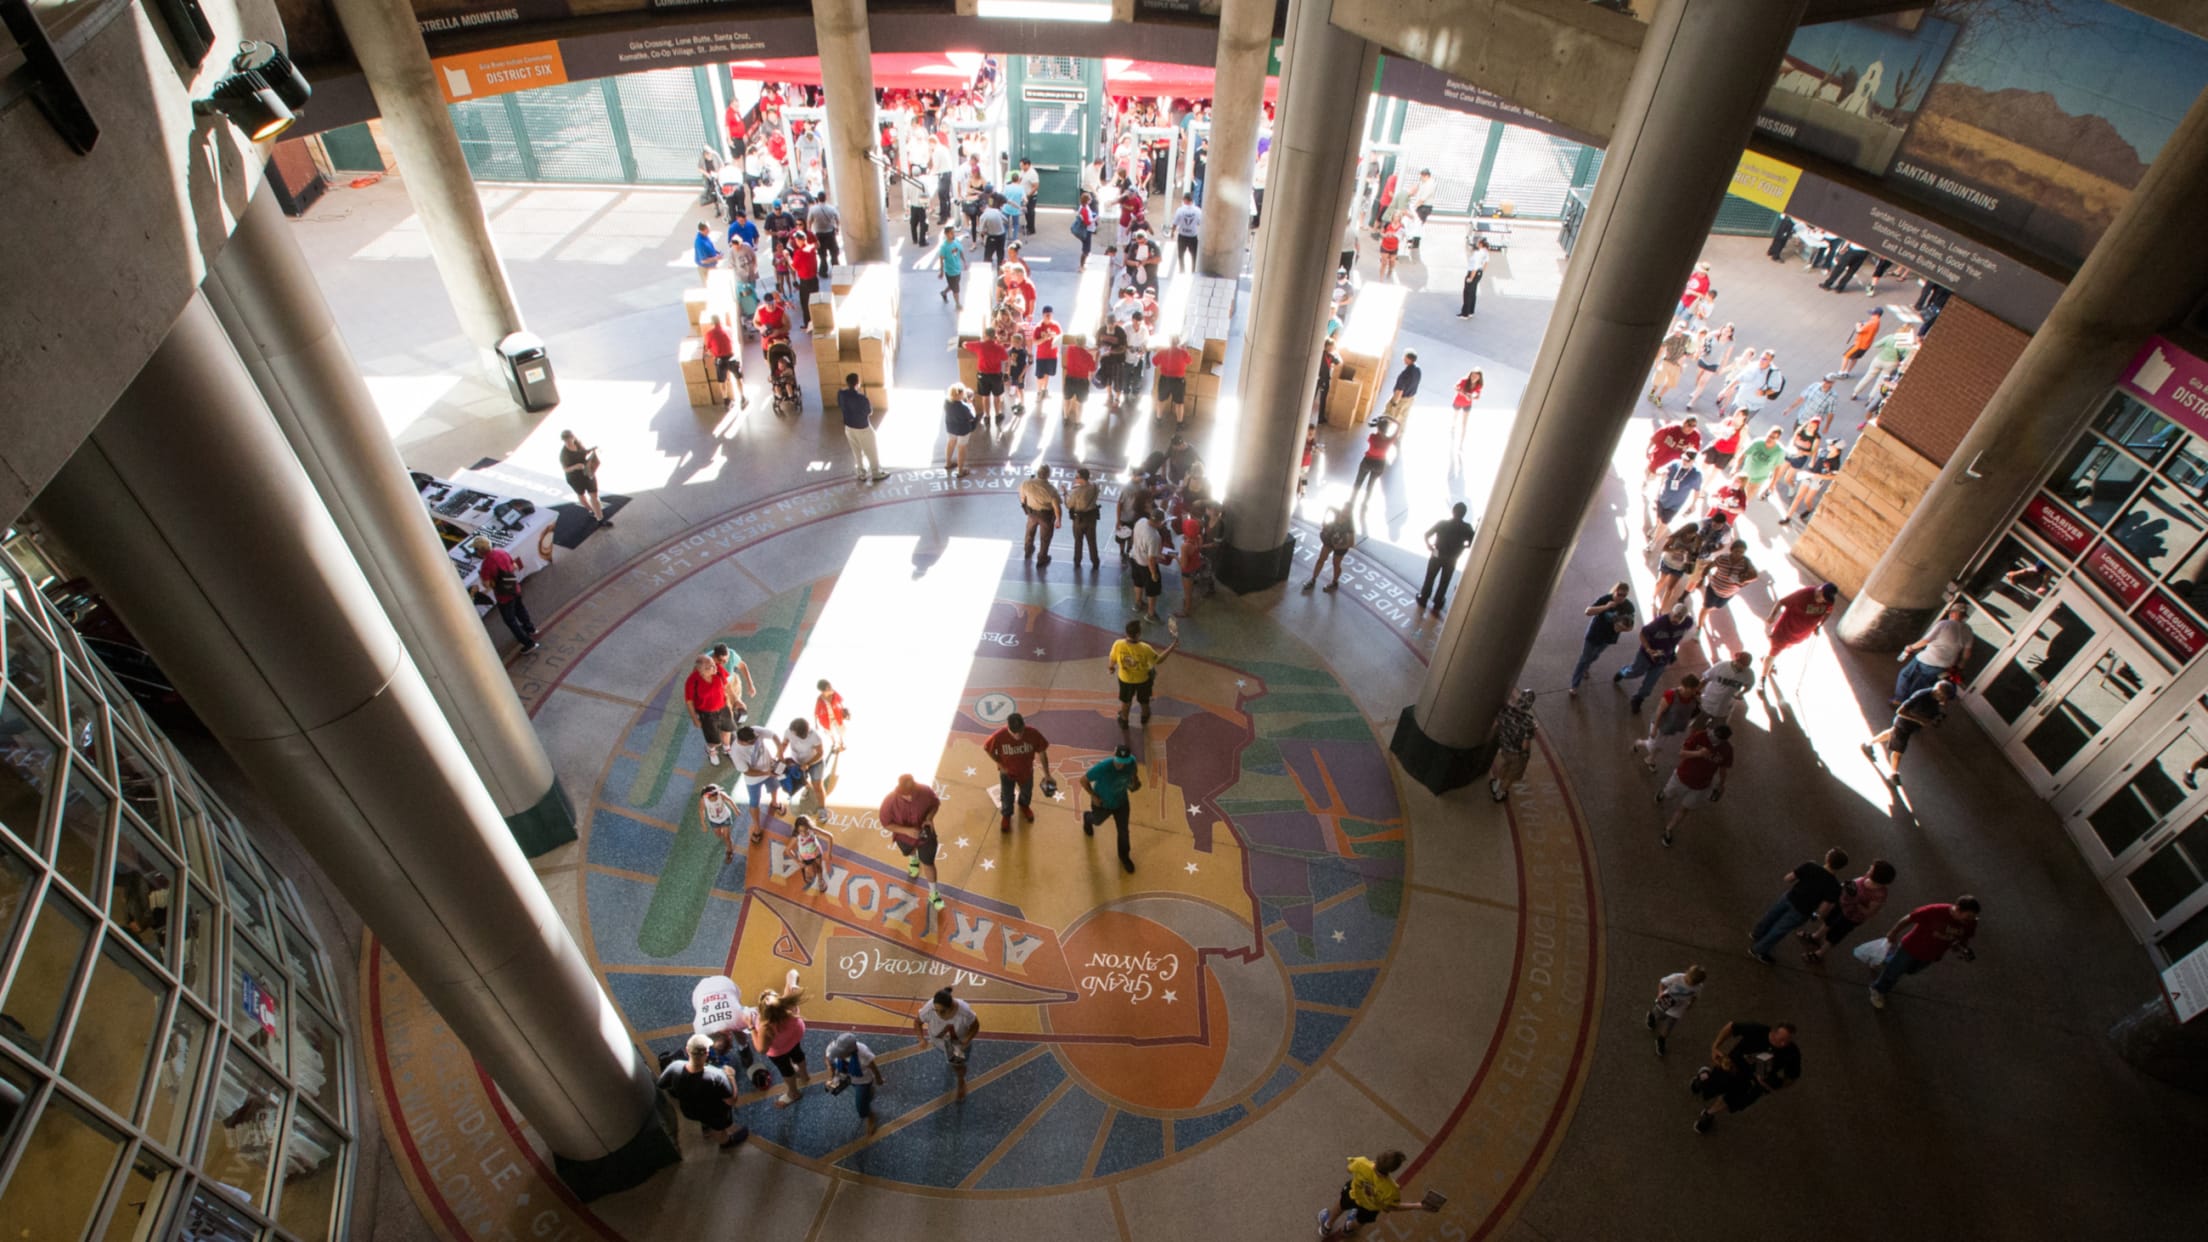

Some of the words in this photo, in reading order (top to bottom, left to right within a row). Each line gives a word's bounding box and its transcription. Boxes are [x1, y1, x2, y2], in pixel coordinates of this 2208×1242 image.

[418, 18, 460, 33] STRELLA
[461, 8, 519, 26] MOUNTAINS
[486, 66, 532, 84] DISTRICT
[535, 63, 553, 77] SIX
[1756, 116, 1797, 138] MISSION
[1733, 171, 1757, 188] RICT
[1758, 179, 1785, 199] FOUR
[1895, 161, 1935, 191] SANTAN
[1935, 177, 1998, 211] MOUNTAINS
[2172, 385, 2208, 418] DISTR
[928, 477, 1015, 493] APACHE
[987, 466, 1079, 481] PHENIX
[777, 485, 848, 511] AYSON
[801, 485, 912, 516] JUNION
[653, 513, 758, 565] PARADISE
[716, 521, 776, 548] MESA
[641, 559, 692, 593] LAK
[1312, 543, 1415, 607] PRESCOT
[980, 631, 1020, 647] DES
[827, 808, 893, 838] OUNTR
[1512, 783, 1546, 843] CHAN
[769, 839, 1045, 976] ARIZONA
[1529, 867, 1555, 985] DOUGLAS
[874, 948, 987, 986] MARICOPA
[1085, 950, 1179, 981] CANYON
[1081, 971, 1153, 1005] GRAND
[702, 1010, 732, 1027] SHUT
[715, 1000, 730, 1010] UP
[1503, 1005, 1543, 1078] ELOY
[432, 1041, 521, 1191] GLENDALE
[403, 1085, 488, 1224] WINSLOW
